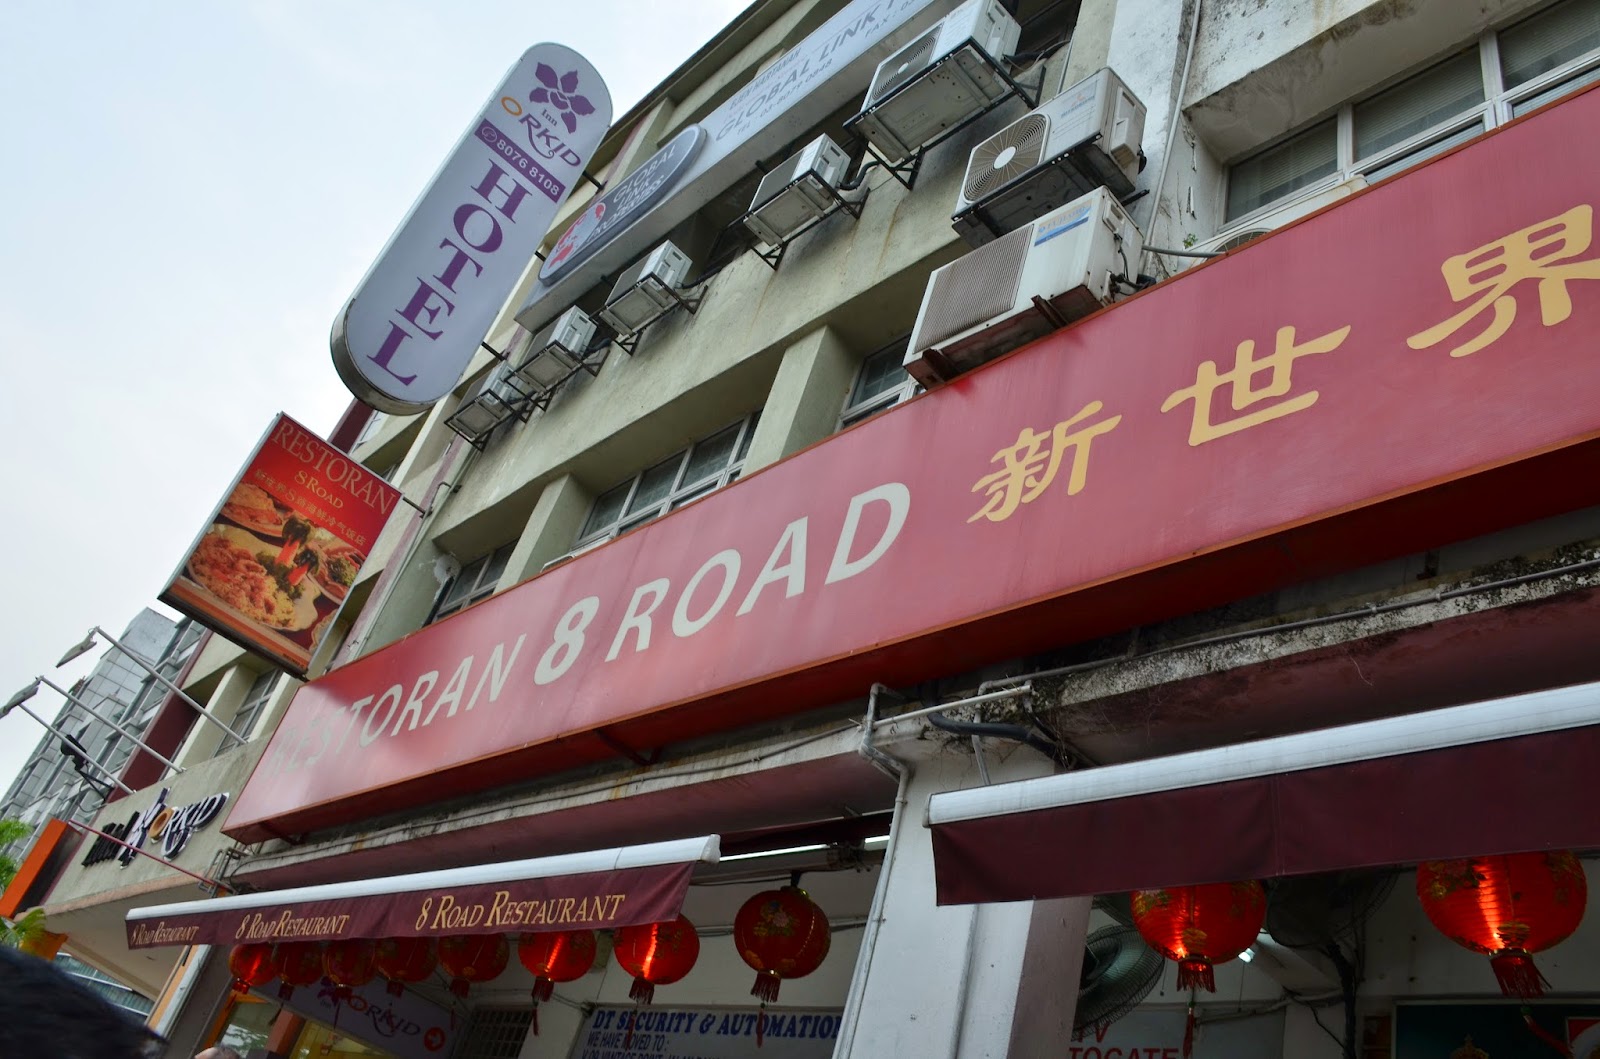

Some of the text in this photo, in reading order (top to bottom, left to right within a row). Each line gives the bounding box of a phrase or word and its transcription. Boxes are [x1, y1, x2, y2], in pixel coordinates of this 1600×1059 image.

[716, 59, 810, 141] GLOBAL
[818, 5, 880, 62] LINK
[501, 96, 581, 168] ORKID
[540, 108, 558, 127] Inn
[496, 138, 561, 197] 8076 8108
[613, 145, 676, 203] GLOBAL
[366, 158, 533, 387] HOTEL
[966, 204, 1600, 523] 新世界
[272, 420, 396, 515] RESTORAN
[305, 478, 344, 509] ROAD
[260, 481, 911, 781] RESTORAN 8 ROAD
[235, 914, 250, 938] 8
[415, 897, 433, 931] 8
[587, 1031, 602, 1047] WE
[600, 1032, 623, 1049] HAVE
[652, 1034, 666, 1052] TO
[593, 1010, 616, 1030] DT
[699, 1013, 716, 1035] &
